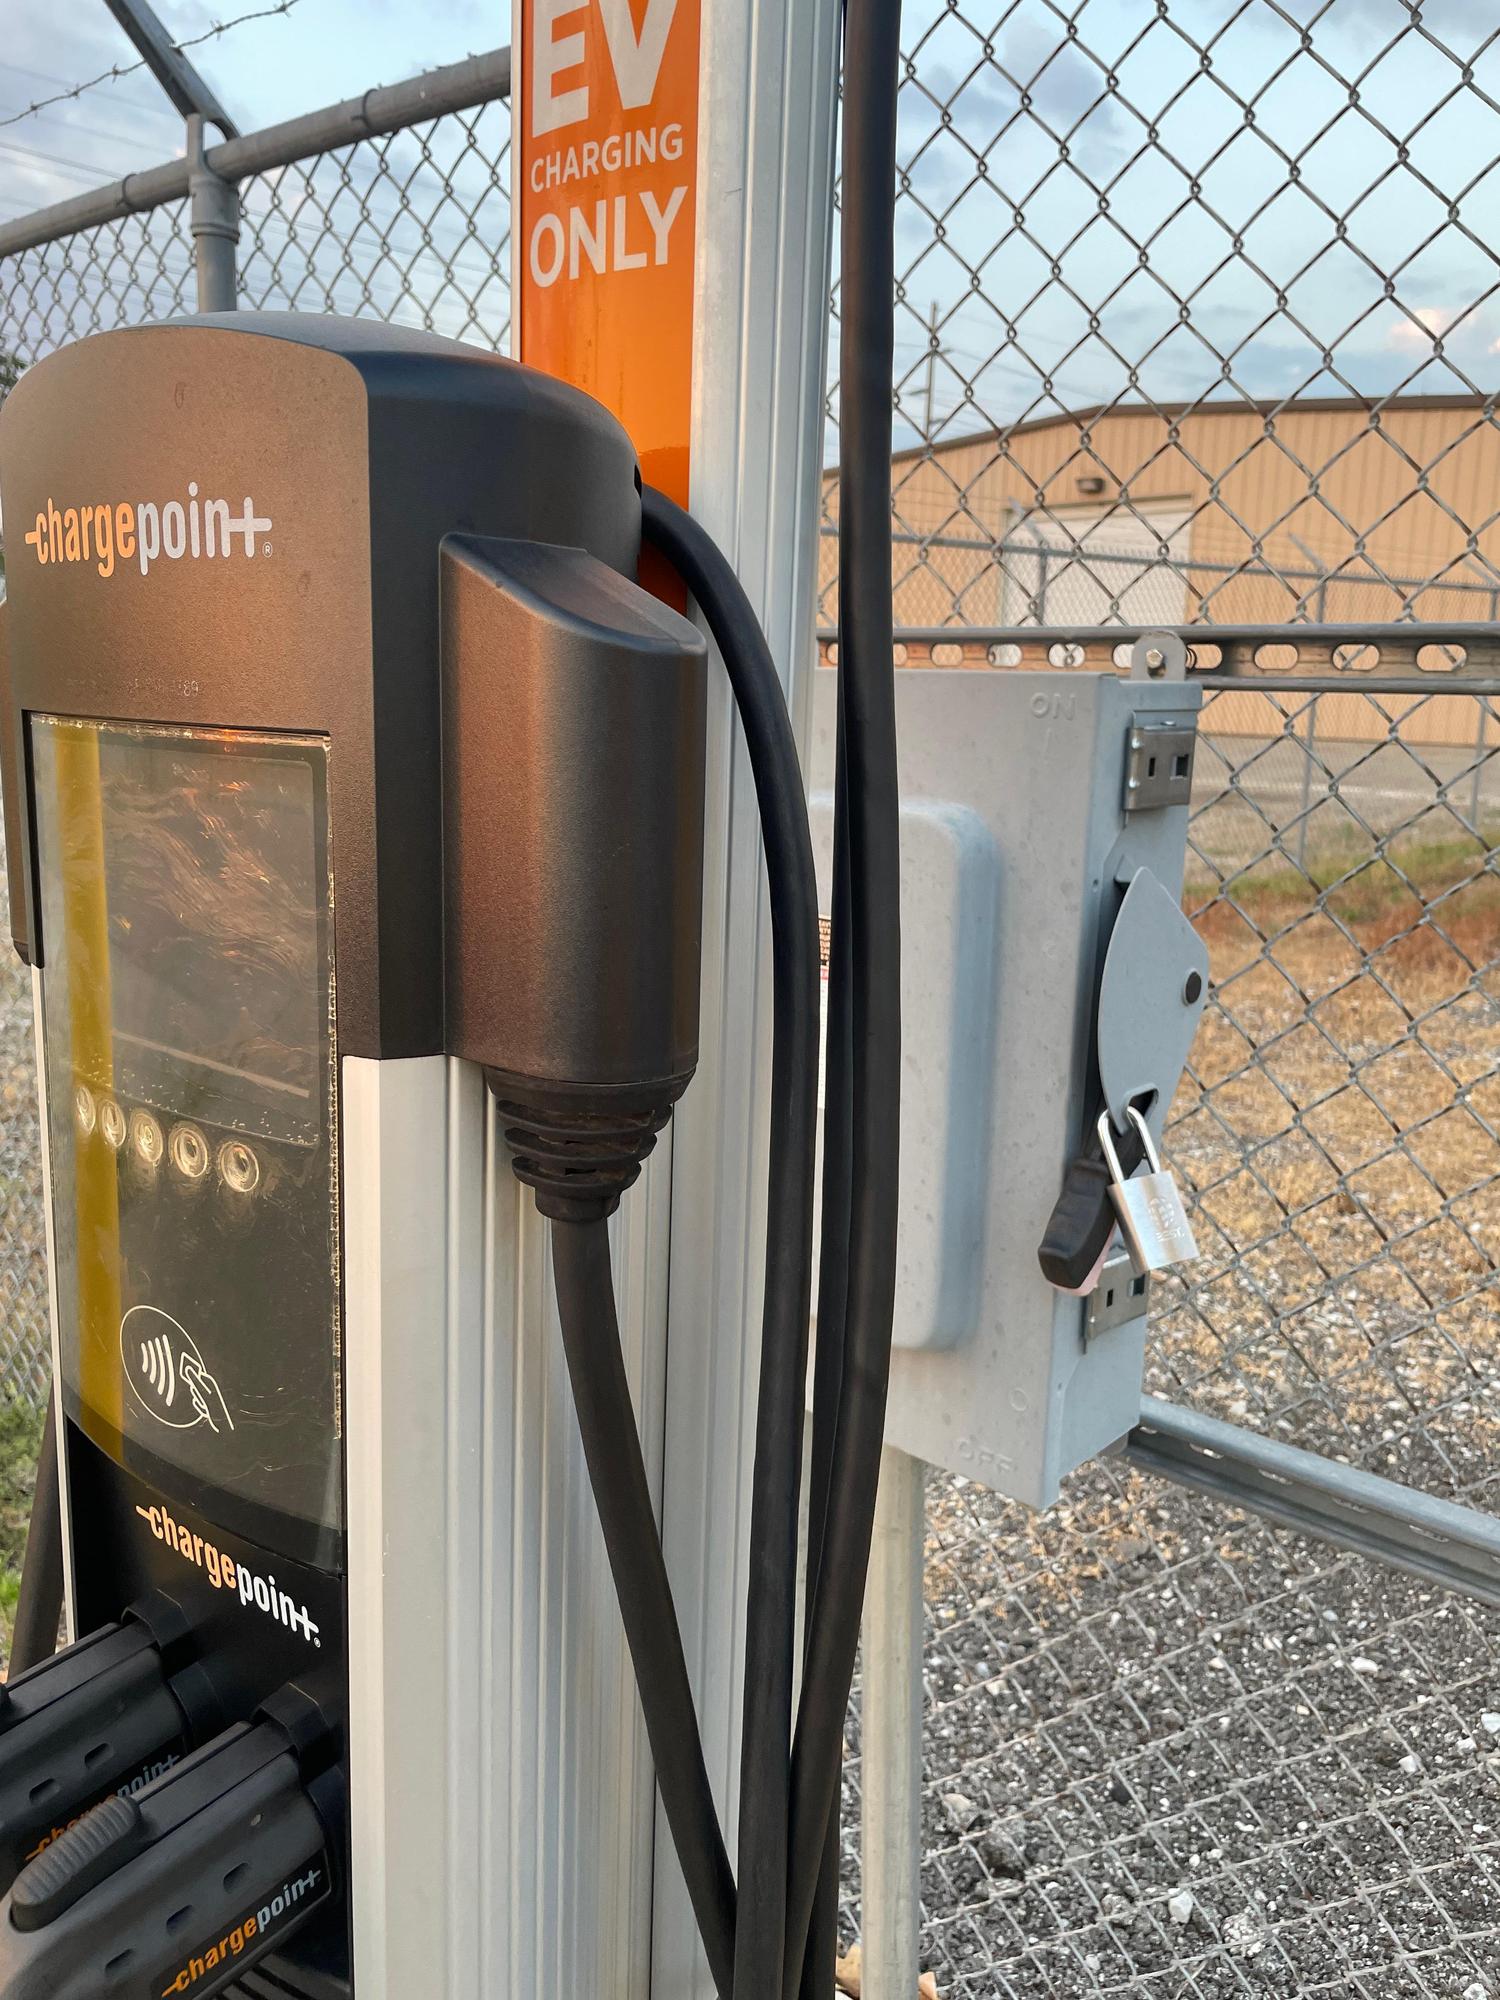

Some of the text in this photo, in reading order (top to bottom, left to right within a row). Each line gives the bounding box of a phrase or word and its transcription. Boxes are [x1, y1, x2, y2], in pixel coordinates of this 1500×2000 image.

[532, 0, 679, 138] EV
[530, 123, 683, 193] CHARGING
[530, 186, 688, 288] ONLY
[1031, 691, 1076, 721] ON
[955, 1438, 1014, 1473] OFF
